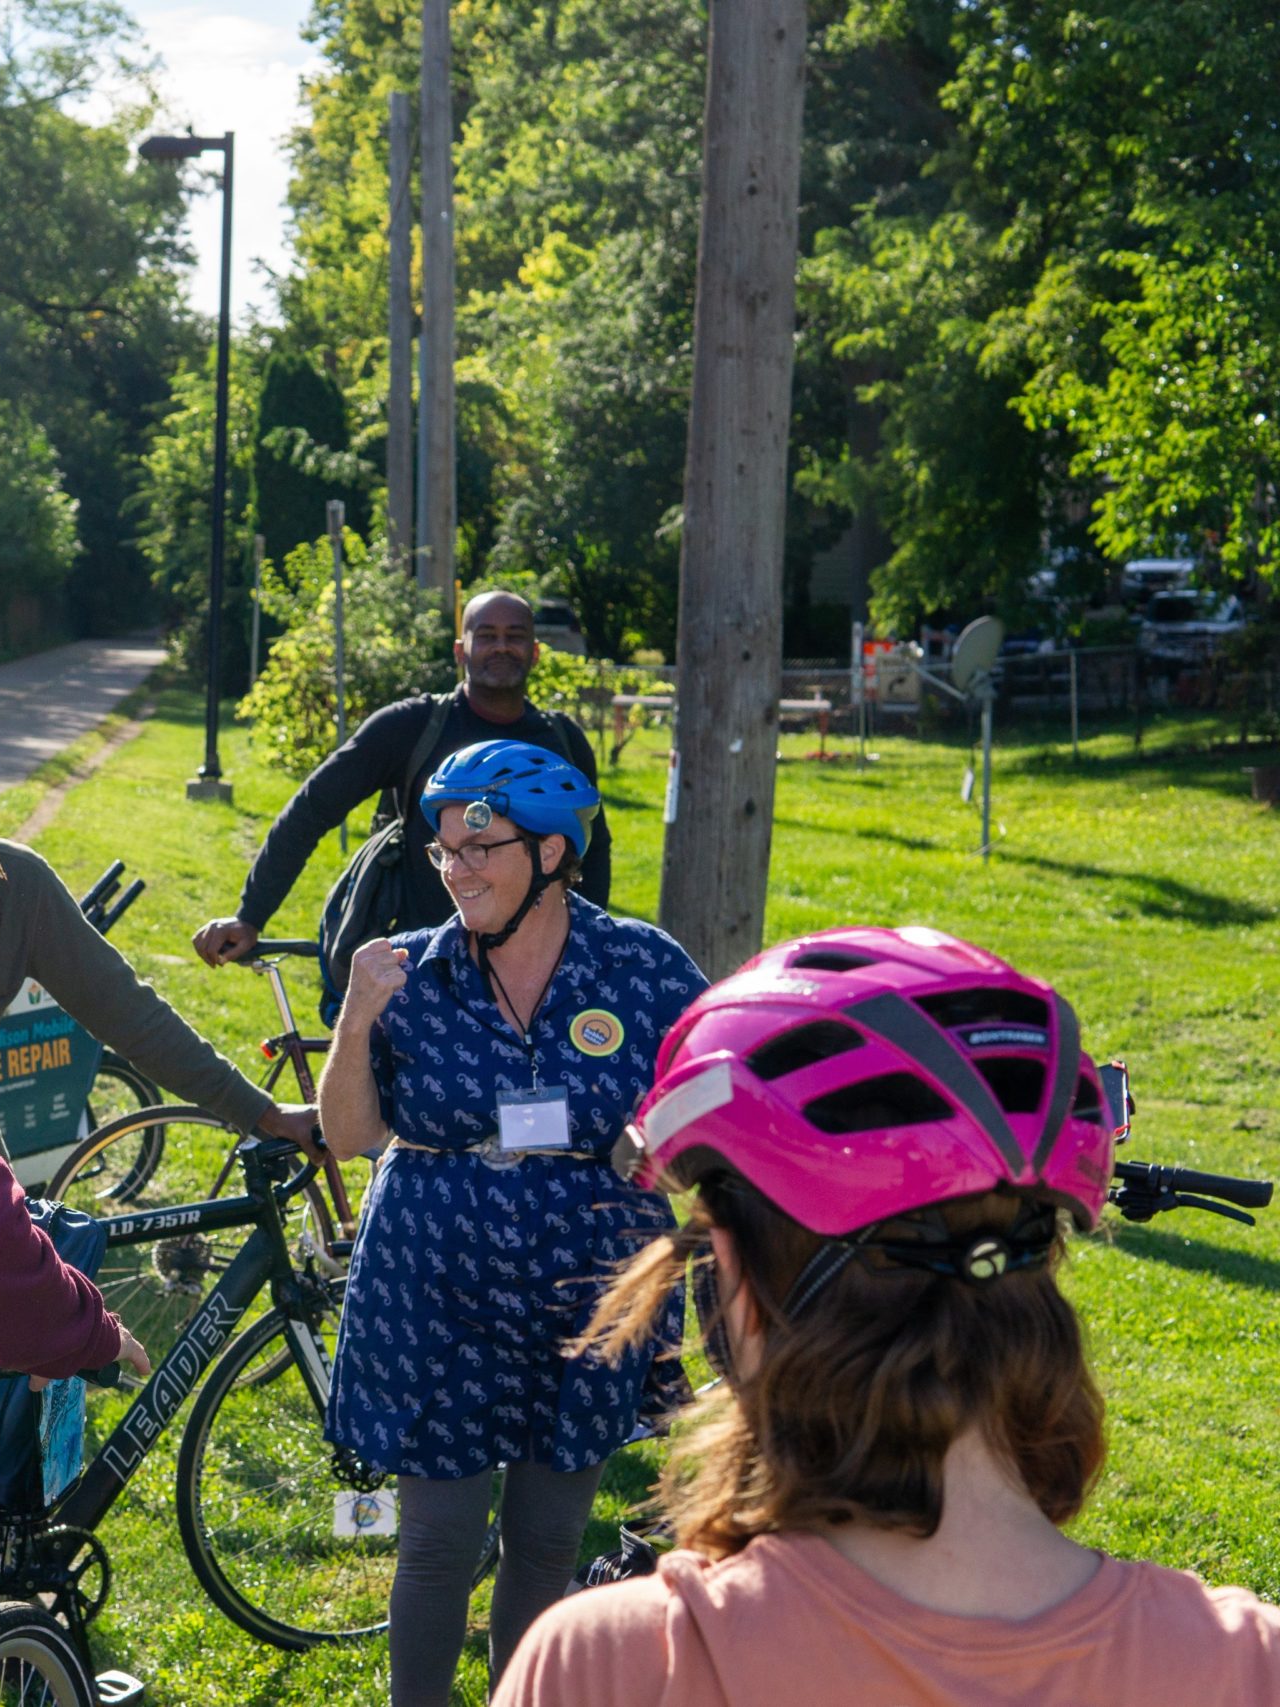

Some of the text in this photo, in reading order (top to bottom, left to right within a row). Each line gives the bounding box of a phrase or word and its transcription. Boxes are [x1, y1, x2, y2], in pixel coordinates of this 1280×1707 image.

[7, 1038, 72, 1078] REPAIR
[109, 1210, 201, 1237] LD-735TR
[103, 1291, 245, 1483] LEADER
